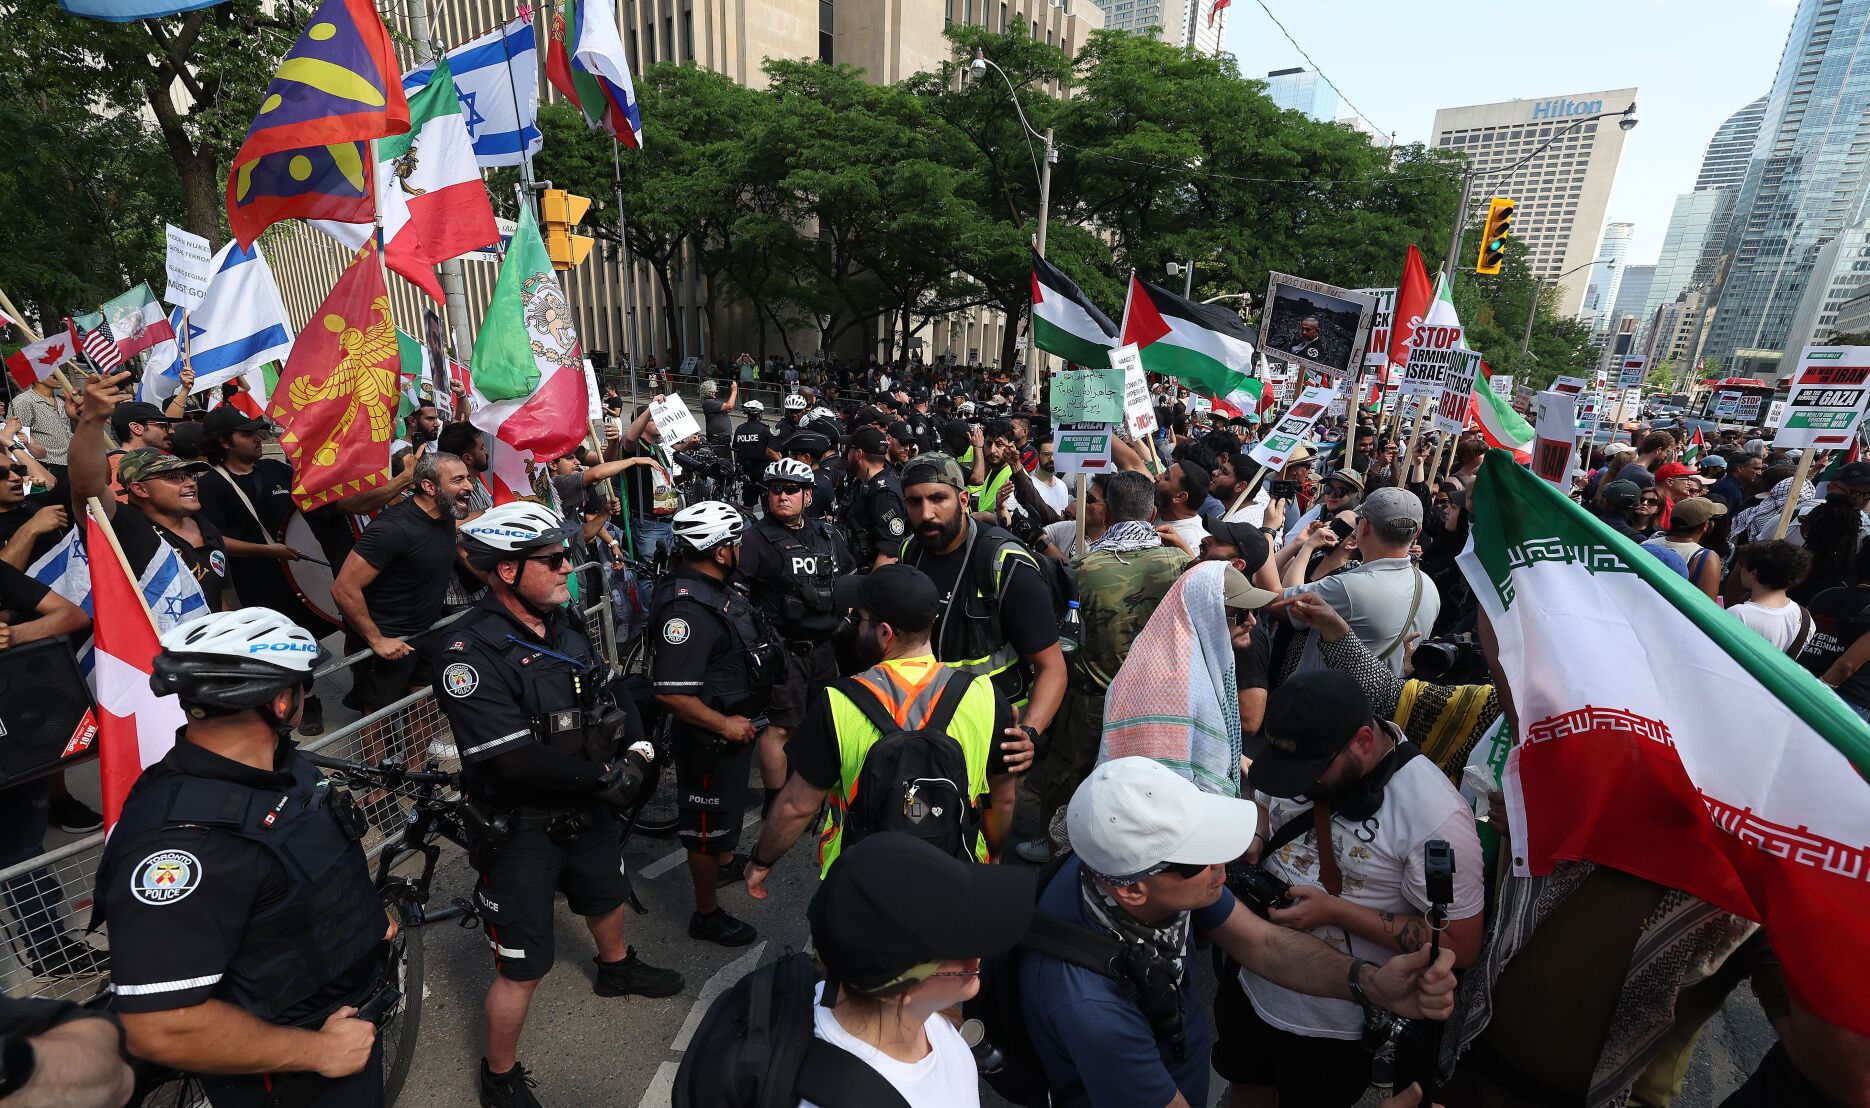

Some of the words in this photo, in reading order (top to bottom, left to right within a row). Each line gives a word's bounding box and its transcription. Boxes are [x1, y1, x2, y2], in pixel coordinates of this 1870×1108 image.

[1533, 99, 1602, 119] Hilton
[186, 241, 211, 254] NUKES
[185, 251, 211, 263] TERROR
[168, 280, 186, 292] MUST
[188, 288, 207, 300] GO!
[1412, 326, 1461, 349] STOP
[1448, 350, 1480, 376] DON'T
[1831, 368, 1869, 383] IRAN
[1445, 373, 1474, 396] ATTACK
[1438, 390, 1468, 422] IRAN
[1819, 390, 1859, 406] GAZA
[738, 434, 759, 442] POLICE
[471, 527, 538, 539] POLICE
[700, 531, 727, 550] POLICE
[80, 725, 96, 745] 100W
[689, 795, 720, 805] POLICE
[147, 853, 192, 866] TORONTO
[145, 888, 180, 900] POLICE
